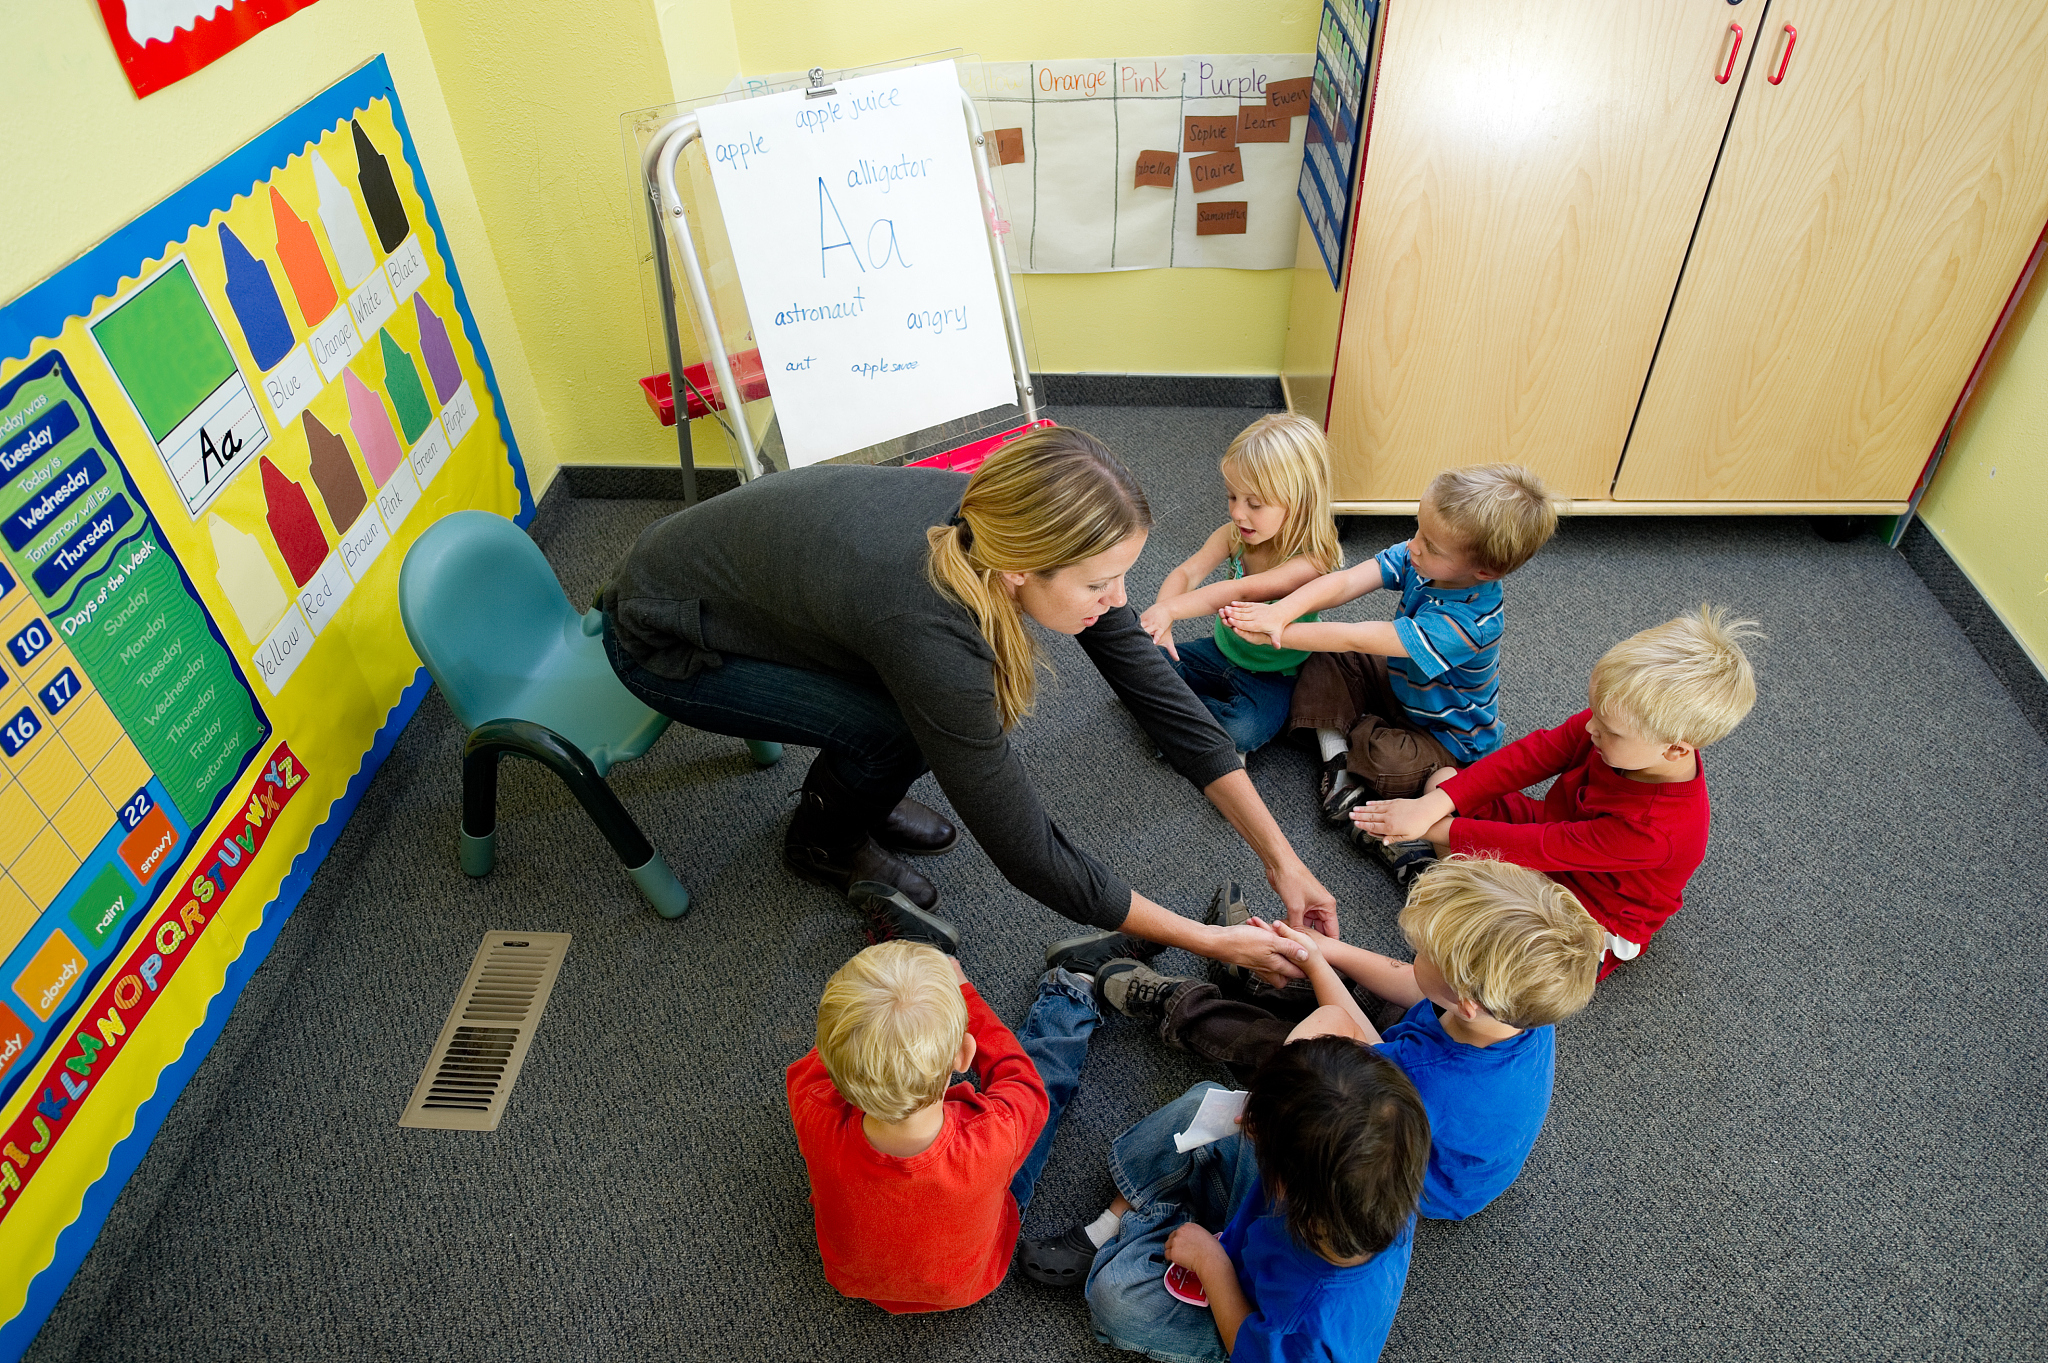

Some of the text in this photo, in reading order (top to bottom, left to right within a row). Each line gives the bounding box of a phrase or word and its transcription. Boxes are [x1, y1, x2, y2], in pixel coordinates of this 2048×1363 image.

[747, 80, 798, 98] Bl
[1038, 67, 1108, 97] Orange
[1121, 61, 1169, 93] Pink
[1199, 60, 1267, 106] Purple
[795, 86, 902, 134] apple juice
[1272, 89, 1309, 108] Ewen
[715, 131, 771, 170] apple
[1189, 124, 1228, 145] Sophie
[847, 153, 933, 194] alligator
[1195, 163, 1236, 182] Claire
[818, 176, 913, 279] Aa
[387, 252, 420, 289] Black
[350, 285, 382, 325] White
[775, 286, 865, 326] astronaut
[907, 305, 968, 334] angry
[313, 323, 352, 366] Orange
[785, 355, 817, 372] ant
[24, 394, 48, 415] was
[266, 375, 301, 410] Blue
[442, 400, 468, 436] Purple
[0, 425, 53, 472] Tuesday
[199, 425, 243, 485] Aa
[413, 441, 439, 476] Green
[17, 457, 63, 494] Today is
[18, 467, 90, 530] Wednesday
[378, 489, 403, 521] Pink
[25, 486, 112, 563] Tomorrow will be
[54, 514, 115, 571] Thursday
[341, 521, 380, 568] Brown
[61, 540, 156, 637] Days of the Week
[301, 573, 333, 620] Red
[104, 587, 150, 637] Sunday
[17, 626, 45, 659] 10
[120, 612, 167, 666] Monday
[255, 626, 300, 682] Yellow
[136, 638, 183, 690] Tuesday
[49, 673, 71, 708] 17
[144, 653, 206, 727] Wednesday
[6, 716, 35, 749] 16
[166, 684, 216, 745] Thursday
[189, 717, 222, 760] Friday
[196, 732, 240, 793] Saturday
[124, 794, 151, 826] 22
[140, 831, 172, 874] snowy
[95, 895, 125, 934] rainy
[40, 958, 79, 1010] cloudy
[0, 1033, 22, 1070] ndy
